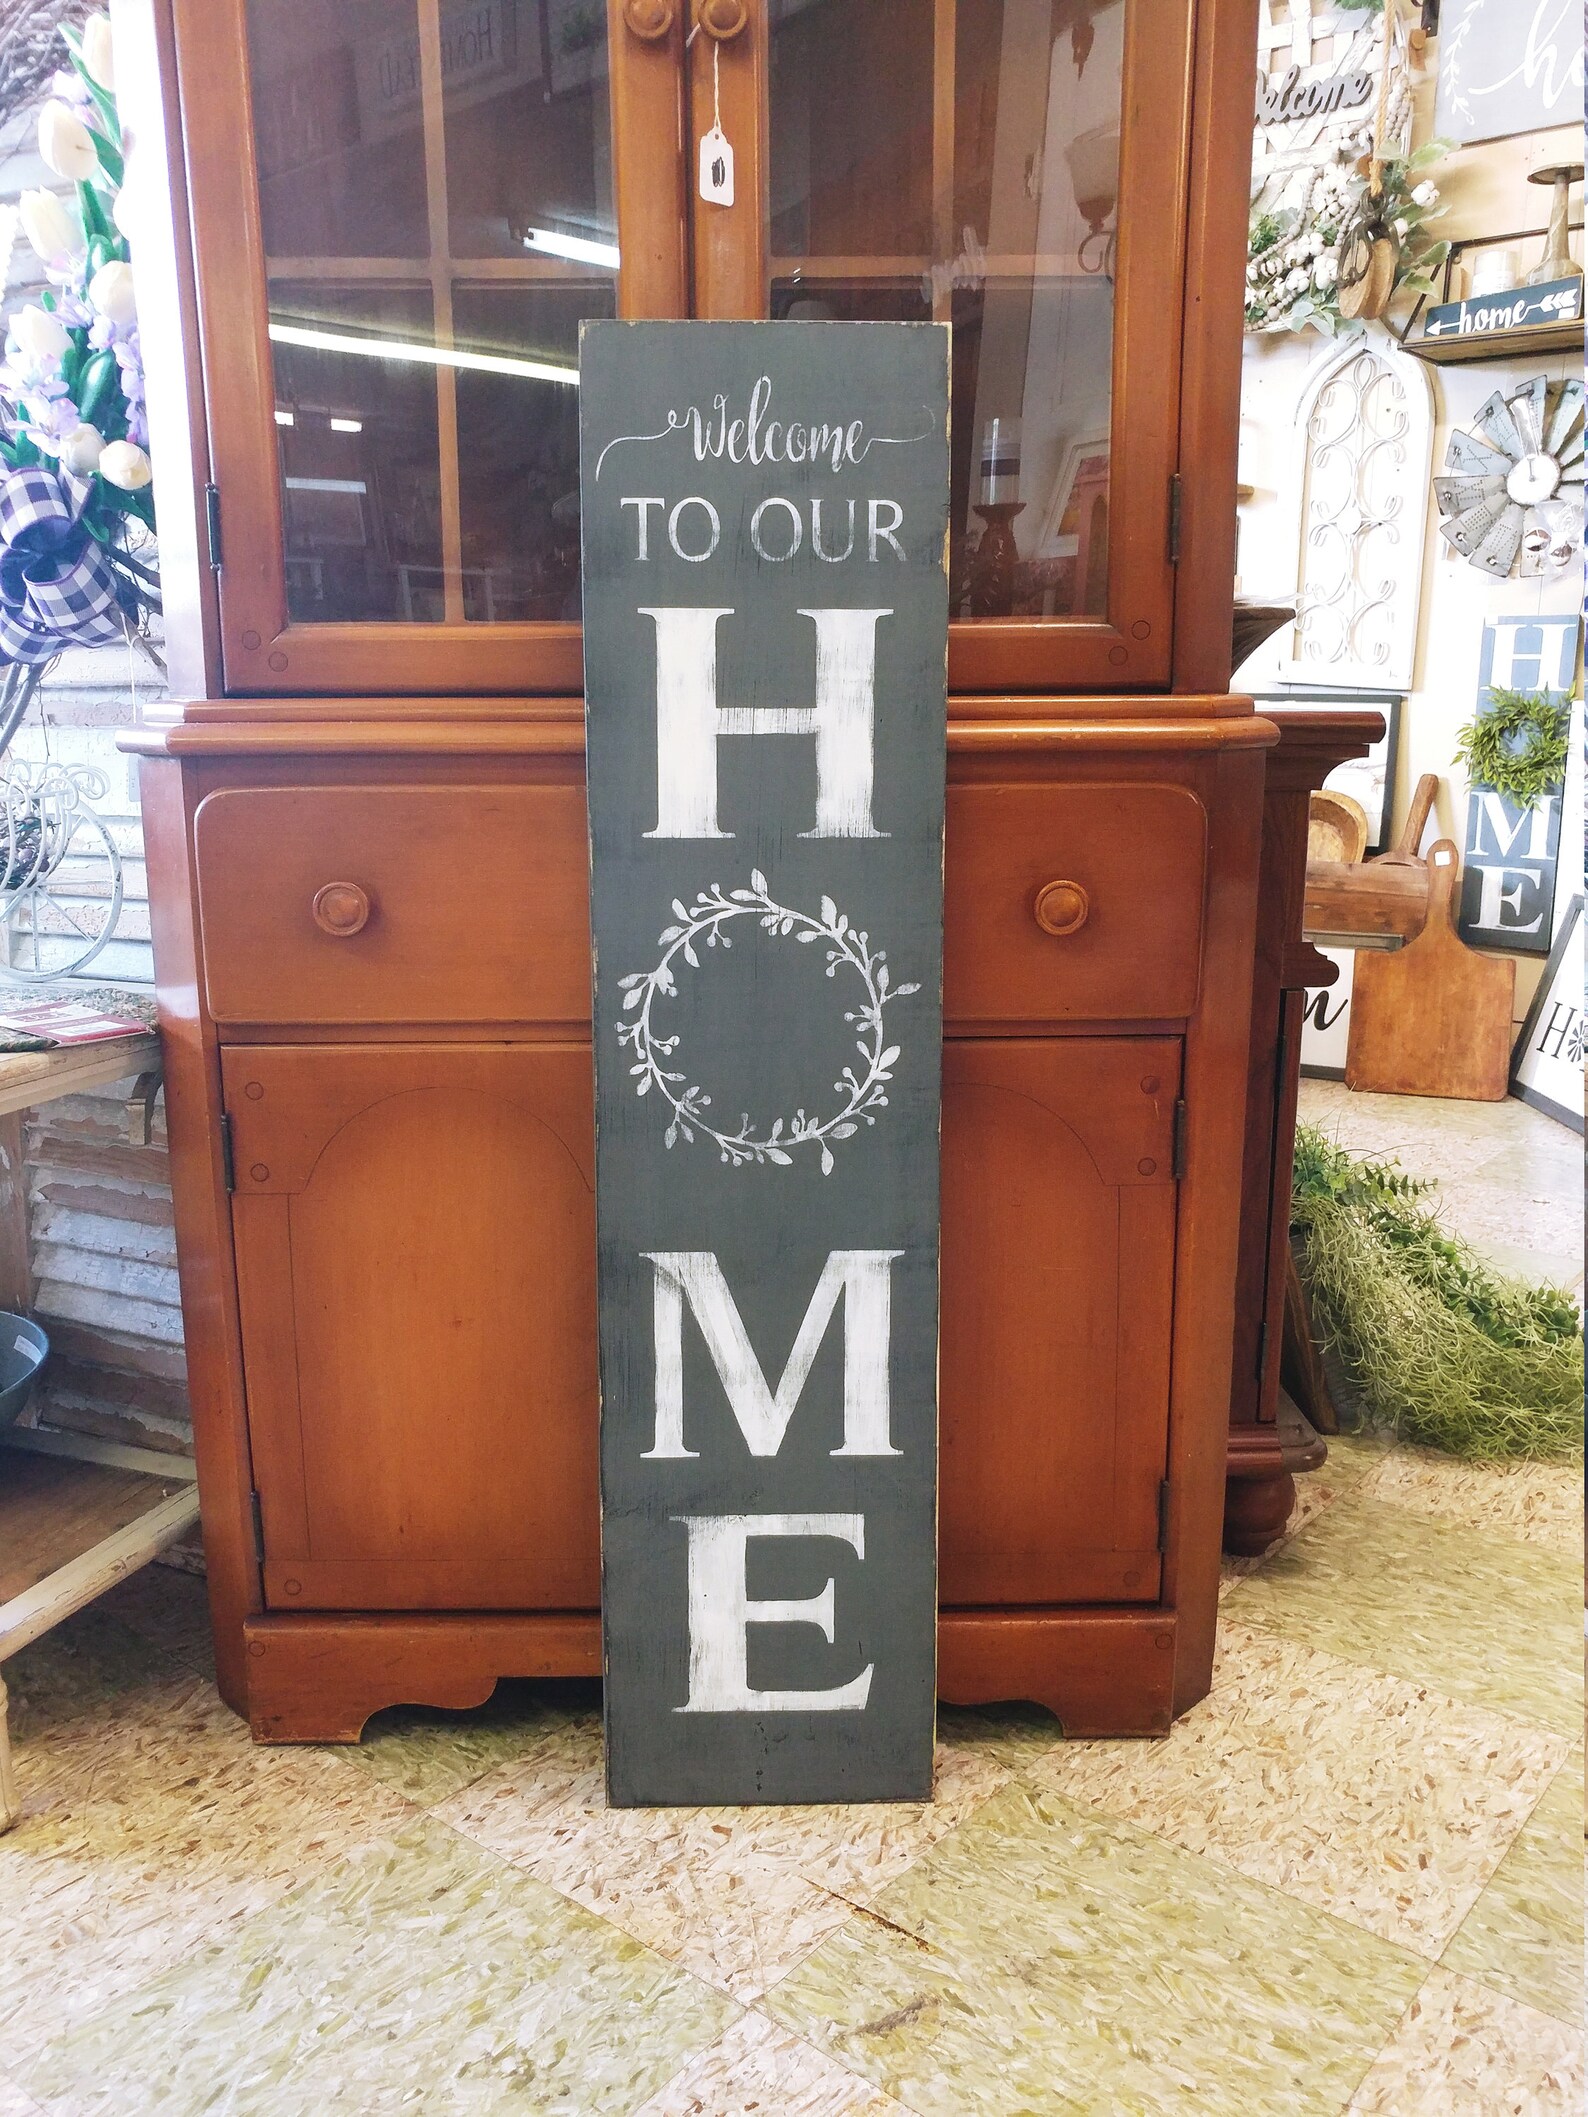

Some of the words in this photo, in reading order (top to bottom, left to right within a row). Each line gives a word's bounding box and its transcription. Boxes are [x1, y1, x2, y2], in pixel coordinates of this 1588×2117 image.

[1459, 299, 1530, 334] home
[650, 375, 890, 472] Welcome
[619, 496, 721, 563] TO
[750, 496, 908, 563] OUR
